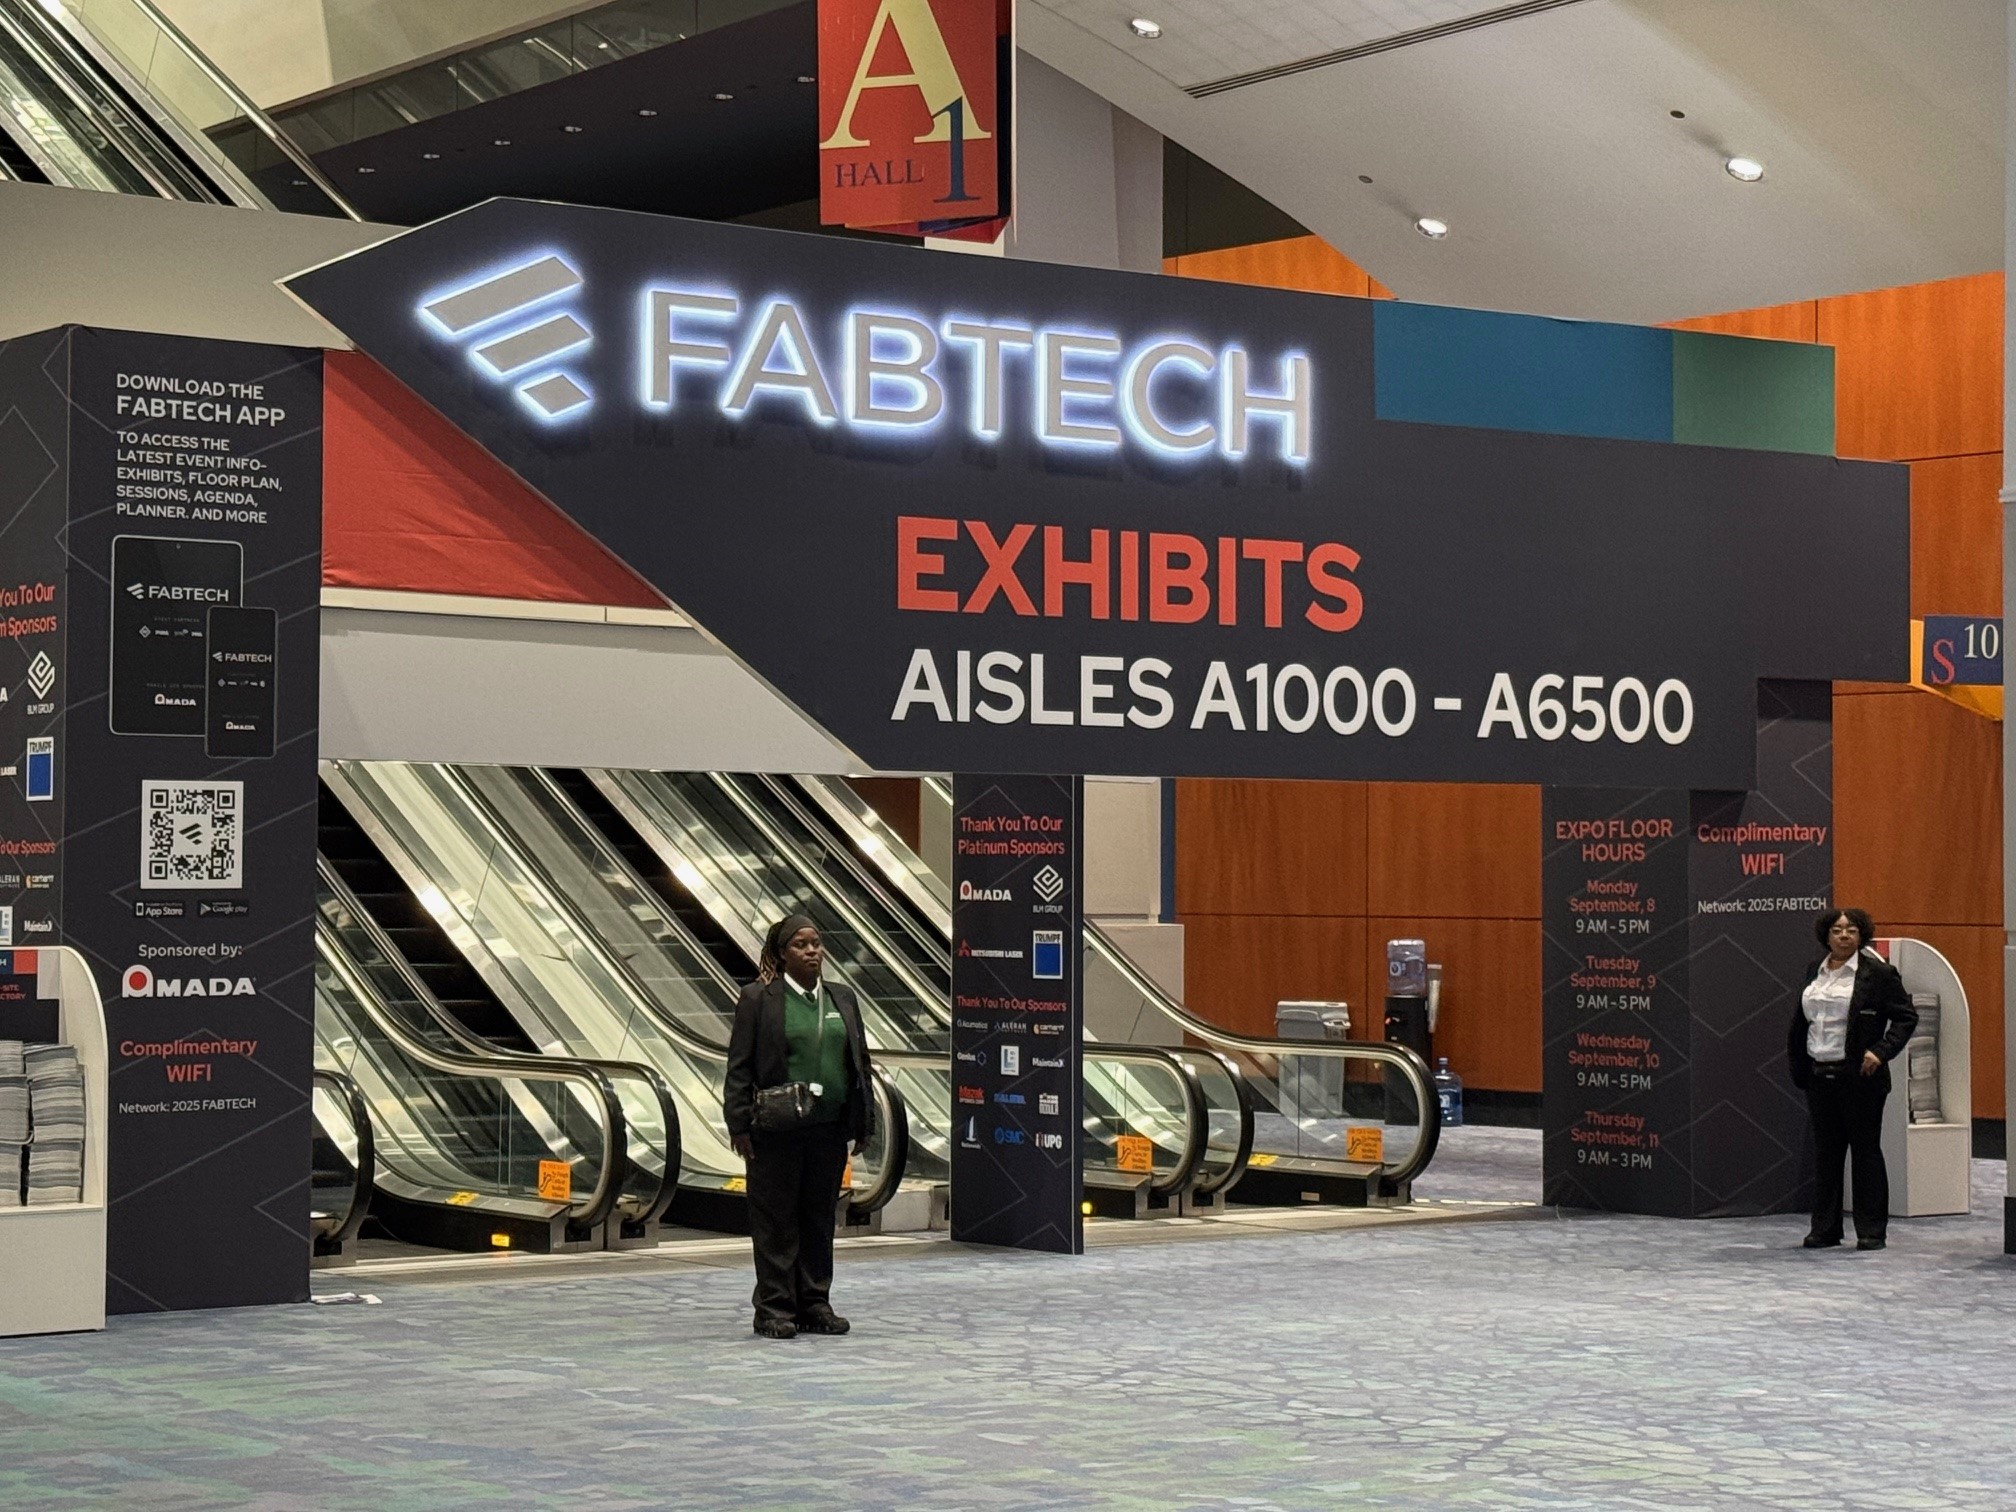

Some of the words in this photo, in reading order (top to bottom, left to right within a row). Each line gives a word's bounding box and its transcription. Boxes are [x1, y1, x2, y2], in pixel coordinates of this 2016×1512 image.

[835, 159, 924, 188] HALL
[642, 286, 1314, 464] FABTECH
[117, 373, 225, 397] DOWNLOAD
[228, 383, 264, 400] THE
[117, 395, 231, 423] FABTECH
[236, 406, 286, 427] APP
[117, 431, 138, 443] TO
[141, 433, 199, 448] ACCESS
[201, 438, 230, 451] THE
[117, 449, 173, 464] LATEST
[176, 454, 224, 468] EVENT
[117, 467, 186, 485] EXHIBITS,
[188, 472, 239, 487] FLOOR
[241, 475, 283, 492] PLAN,
[116, 485, 191, 503] SESSIONS,
[194, 491, 259, 507] AGENDA,
[191, 508, 223, 521] AND
[226, 510, 267, 524] MORE
[896, 515, 1364, 632] EXHIBITS
[19, 585, 34, 605] To
[34, 582, 56, 603] Our
[148, 586, 229, 602] FABTECH
[8, 615, 57, 641] Sponsors
[225, 652, 272, 663] FABTECH
[1930, 638, 1956, 685] S
[154, 693, 197, 706] AMADA
[891, 649, 1175, 729] AISLES
[1190, 661, 1417, 738] A1000
[1476, 672, 1695, 745] A6500
[29, 741, 52, 753] TRUMPF
[960, 816, 995, 832] Thank
[997, 816, 1020, 832] You
[1022, 815, 1039, 831] To
[1040, 815, 1063, 831] Our
[1556, 820, 1605, 839] EXPO
[1608, 819, 1673, 839] FLOOR
[1697, 821, 1827, 846] Complimentary
[6, 841, 21, 854] Our
[21, 840, 55, 858] Sponsors
[958, 839, 1009, 855] Platinum
[1010, 839, 1065, 858] Sponsors
[1582, 843, 1646, 862] HOURS
[1741, 853, 1784, 875] WIFI
[960, 880, 1012, 901] AMADA
[1586, 880, 1638, 897] Monday
[145, 907, 162, 917] App
[163, 907, 183, 916] Store
[212, 906, 234, 915] Google
[1570, 898, 1644, 915] September,
[1647, 898, 1656, 912] 8
[1698, 899, 1746, 914] Network:
[1748, 898, 1774, 912] 2025
[1776, 897, 1827, 911] FABTECH
[1575, 919, 1584, 933] 9
[1586, 919, 1607, 933] AM
[1618, 919, 1627, 934] 5
[1629, 919, 1650, 934] PM
[1035, 933, 1061, 943] TRUMPF
[138, 943, 216, 959] Sponsored
[221, 943, 242, 958] by:
[1586, 955, 1640, 974] Tuesday
[122, 964, 256, 998] AMADA
[1570, 972, 1644, 991] September,
[1647, 975, 1656, 989] 9
[0, 992, 27, 1000] CTORY
[956, 995, 981, 1009] Thank
[982, 998, 998, 1009] You
[999, 998, 1010, 1010] To
[1011, 999, 1026, 1011] Our
[1027, 999, 1067, 1013] Sponsors
[1576, 994, 1585, 1008] 9
[1587, 995, 1608, 1009] AM
[1619, 995, 1627, 1010] 5
[1630, 995, 1651, 1010] PM
[120, 1039, 258, 1059] Complimentary
[1577, 1032, 1651, 1052] Wednesday
[1568, 1050, 1643, 1069] September,
[1645, 1053, 1659, 1068] 10
[166, 1063, 211, 1083] WIFI
[1577, 1072, 1585, 1086] 9
[1587, 1073, 1609, 1087] AM
[1620, 1074, 1628, 1088] 5
[1631, 1075, 1651, 1090] PM
[119, 1102, 170, 1114] Network:
[172, 1100, 200, 1112] 2025
[202, 1098, 256, 1110] FABTECH
[1585, 1111, 1645, 1131] Thursday
[1044, 1134, 1062, 1149] UPG
[1570, 1128, 1646, 1149] September,
[1649, 1133, 1659, 1148] 11
[1577, 1149, 1586, 1163] 9
[1588, 1150, 1609, 1165] AM
[1620, 1153, 1628, 1167] 3
[1632, 1154, 1652, 1169] PM
